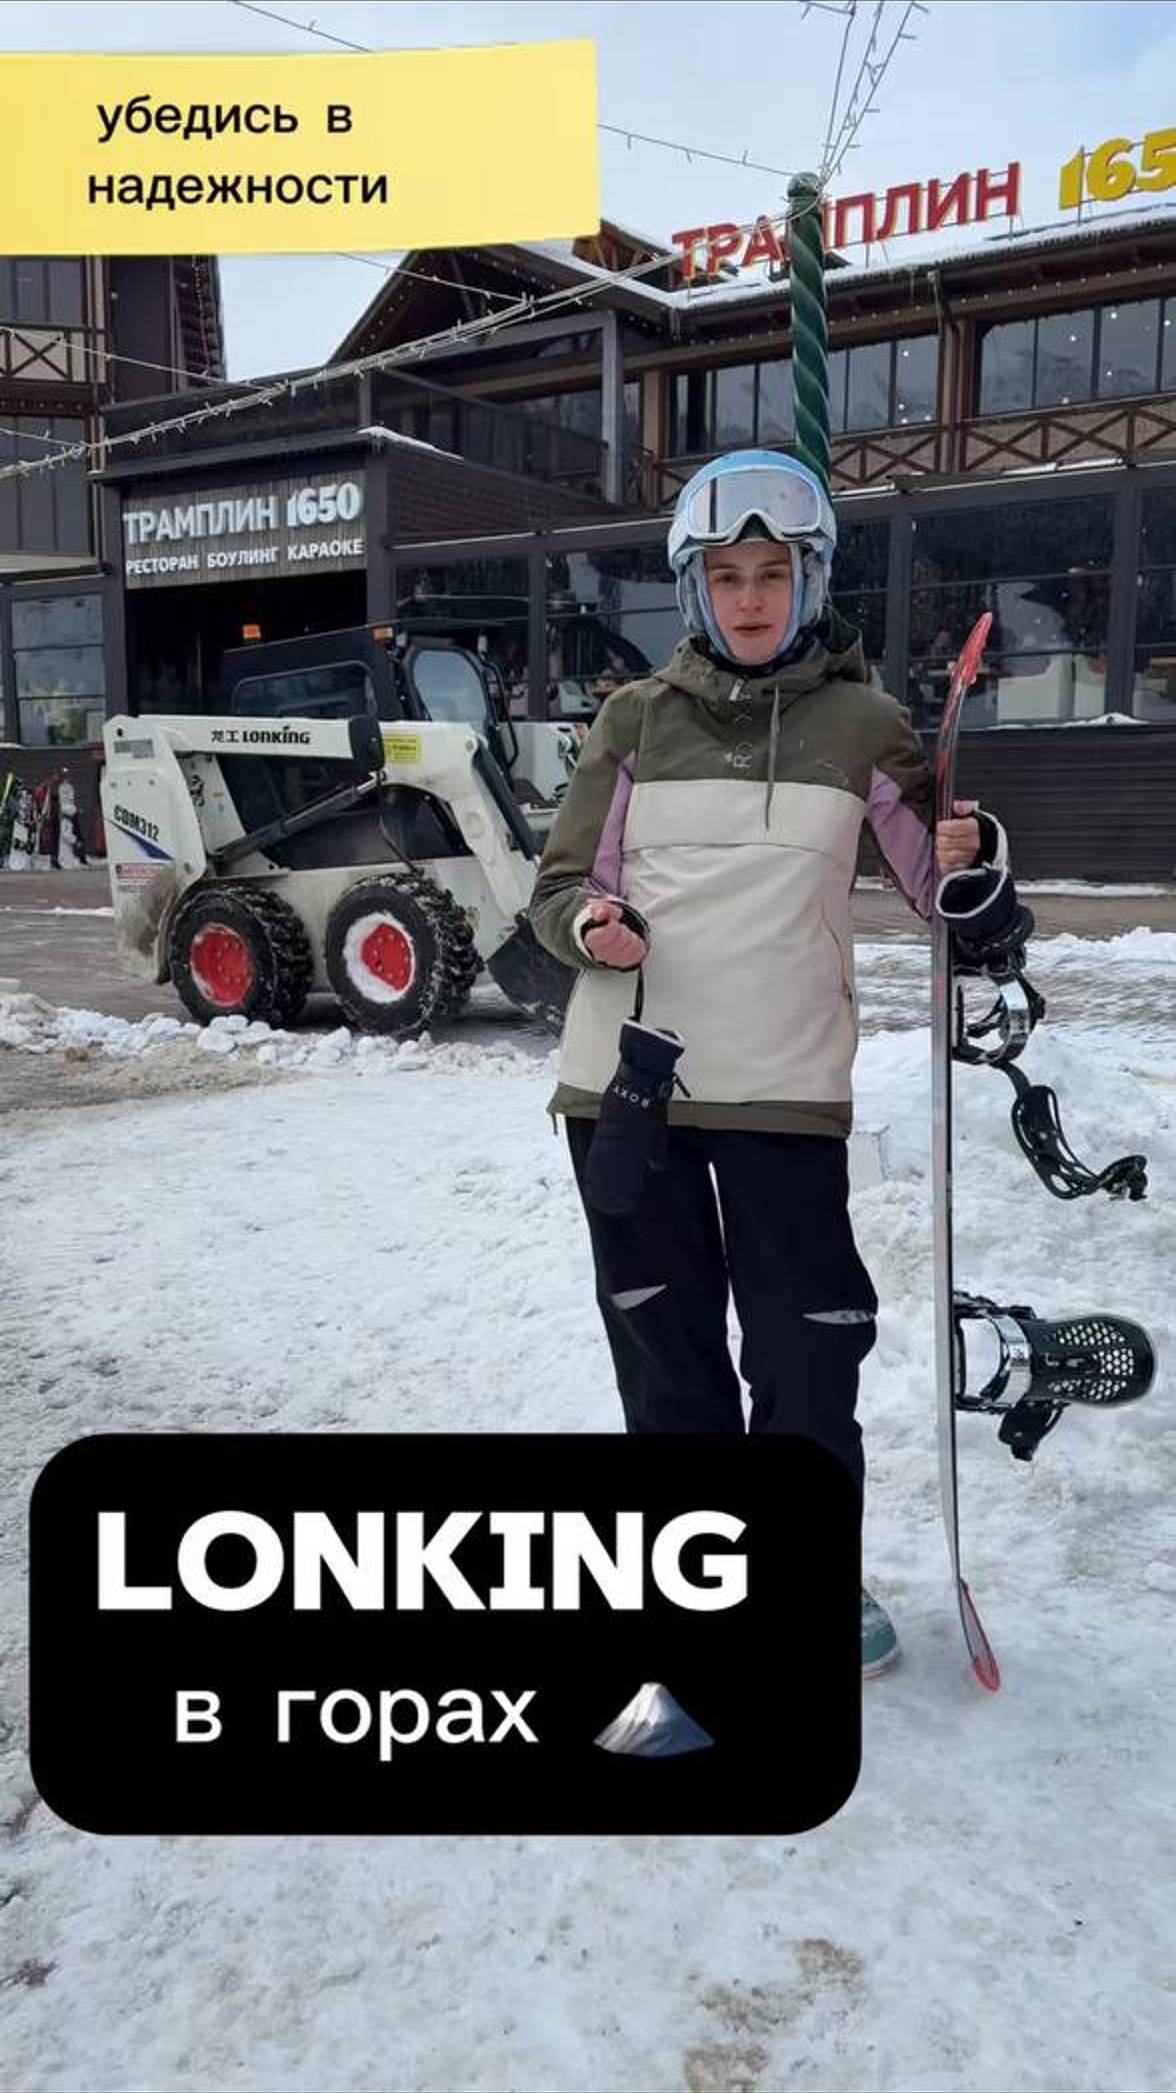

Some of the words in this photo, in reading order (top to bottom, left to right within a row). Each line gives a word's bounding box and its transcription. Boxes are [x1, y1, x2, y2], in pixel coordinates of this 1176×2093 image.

[123, 495, 279, 545] ТРАМПЛИН
[286, 482, 363, 528] 1650
[126, 554, 199, 576] РЕСТОРАН
[207, 546, 279, 569] БОУЛИНГ
[287, 538, 363, 561] КАРАОКЕ
[113, 805, 159, 841] CDM312
